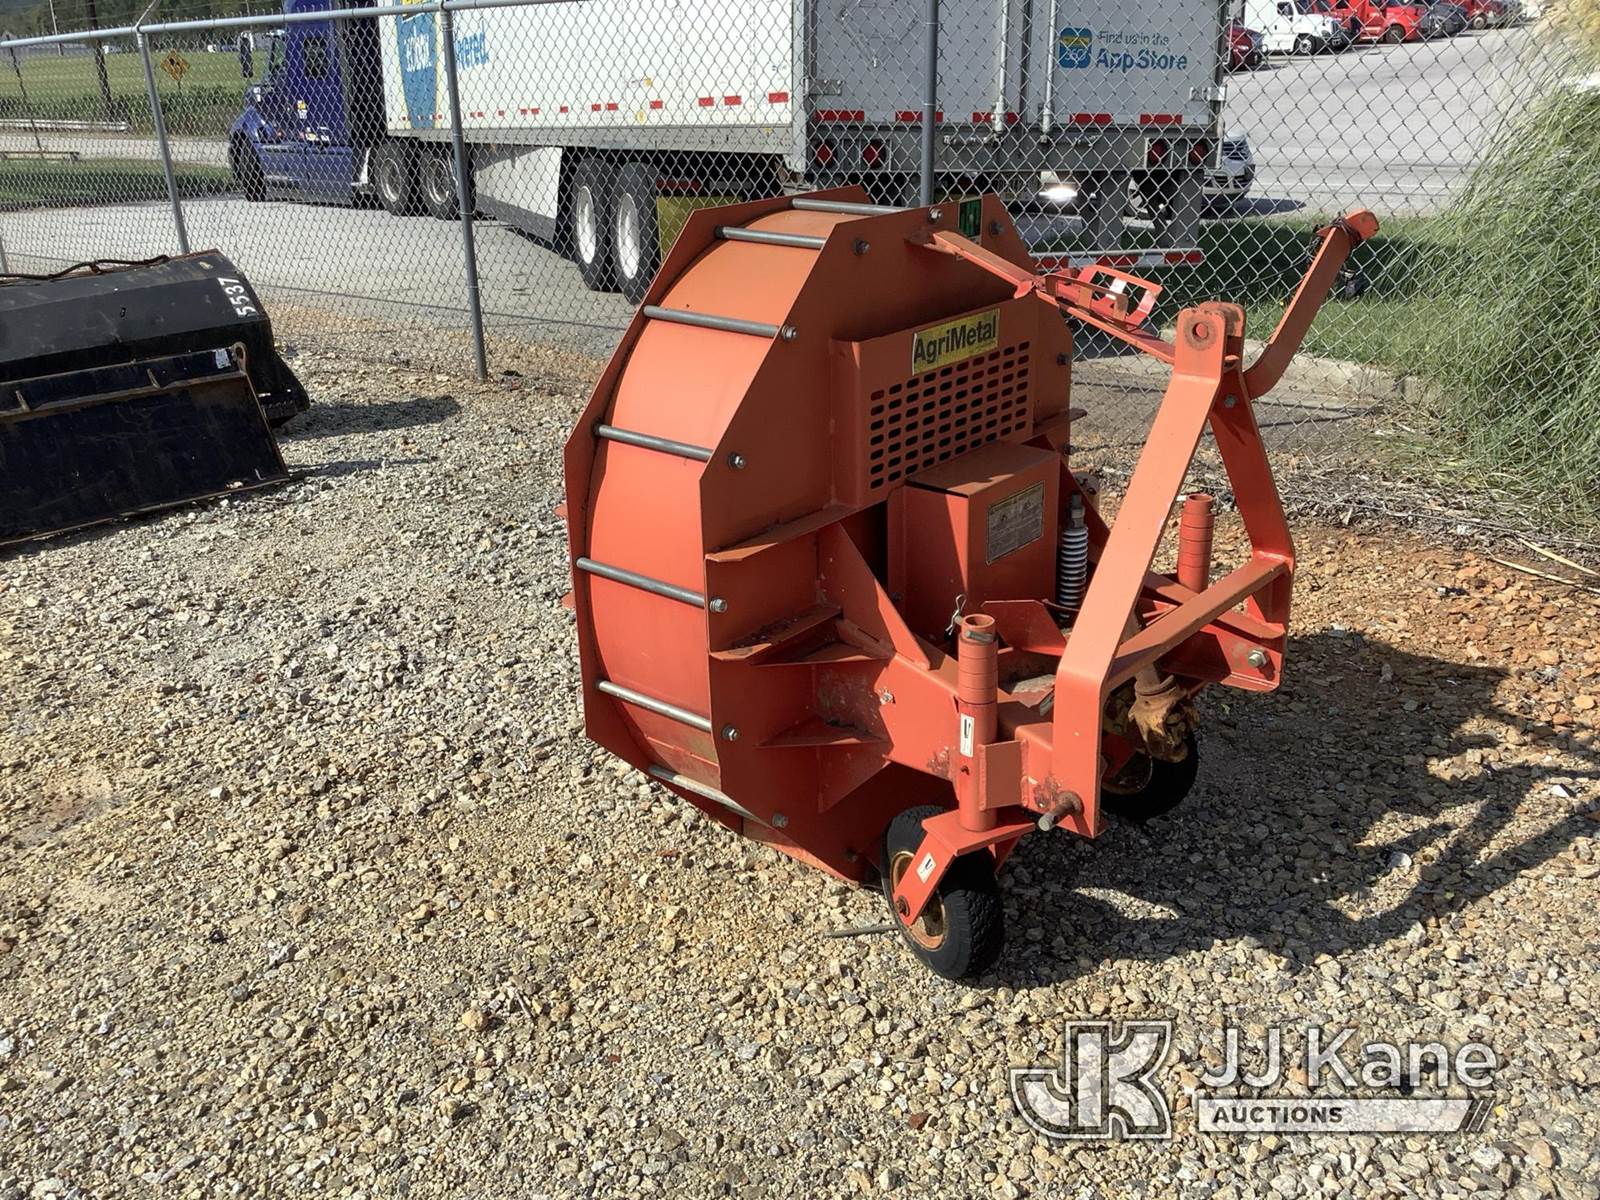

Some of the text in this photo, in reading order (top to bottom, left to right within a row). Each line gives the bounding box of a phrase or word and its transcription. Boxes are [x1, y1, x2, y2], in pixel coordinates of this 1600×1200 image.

[1098, 31, 1170, 46] Find us in the
[1096, 48, 1188, 73] App Store
[217, 277, 257, 317] 5537
[914, 314, 997, 365] AgriMetal
